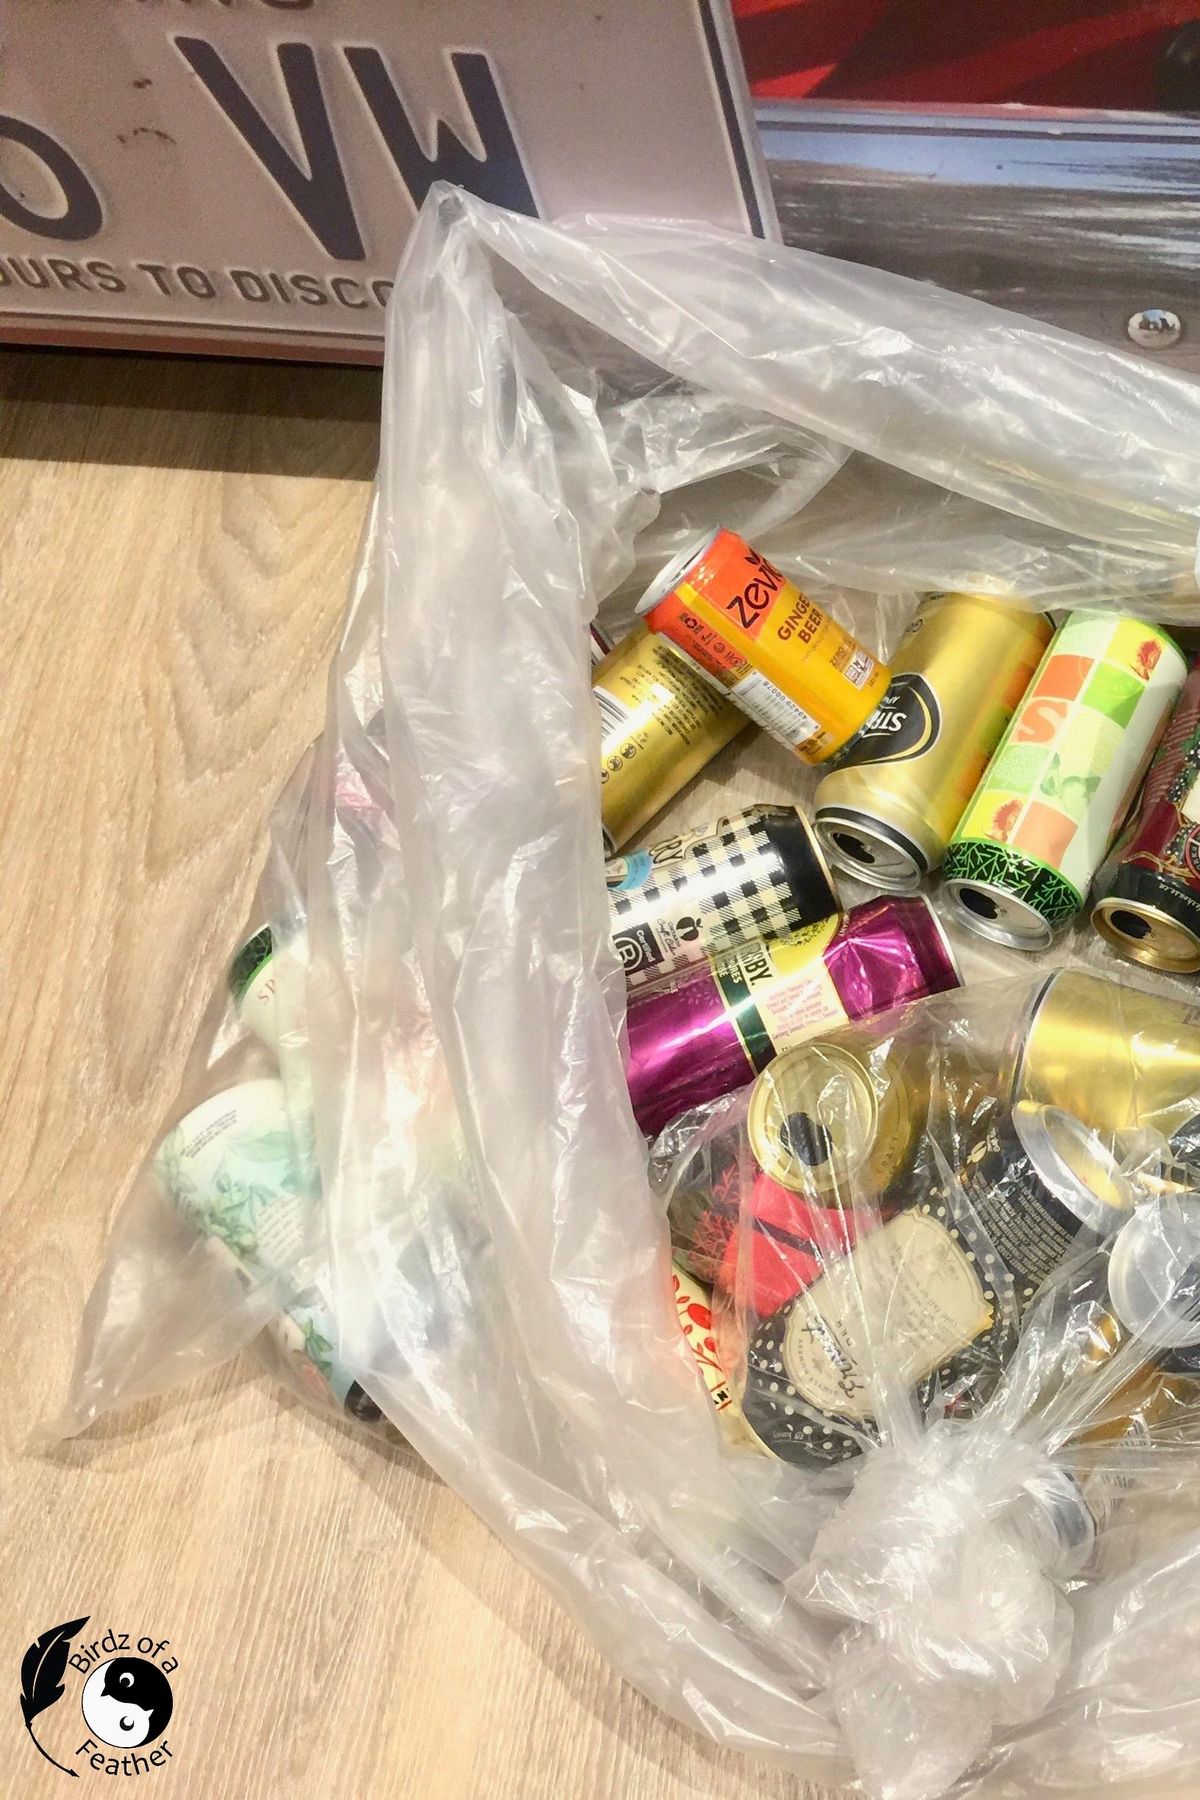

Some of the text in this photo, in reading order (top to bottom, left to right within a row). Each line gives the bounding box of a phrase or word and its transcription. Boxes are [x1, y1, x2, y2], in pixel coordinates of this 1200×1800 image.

[137, 263, 216, 299] TO
[798, 608, 824, 644] BEER
[636, 929, 655, 962] Certified
